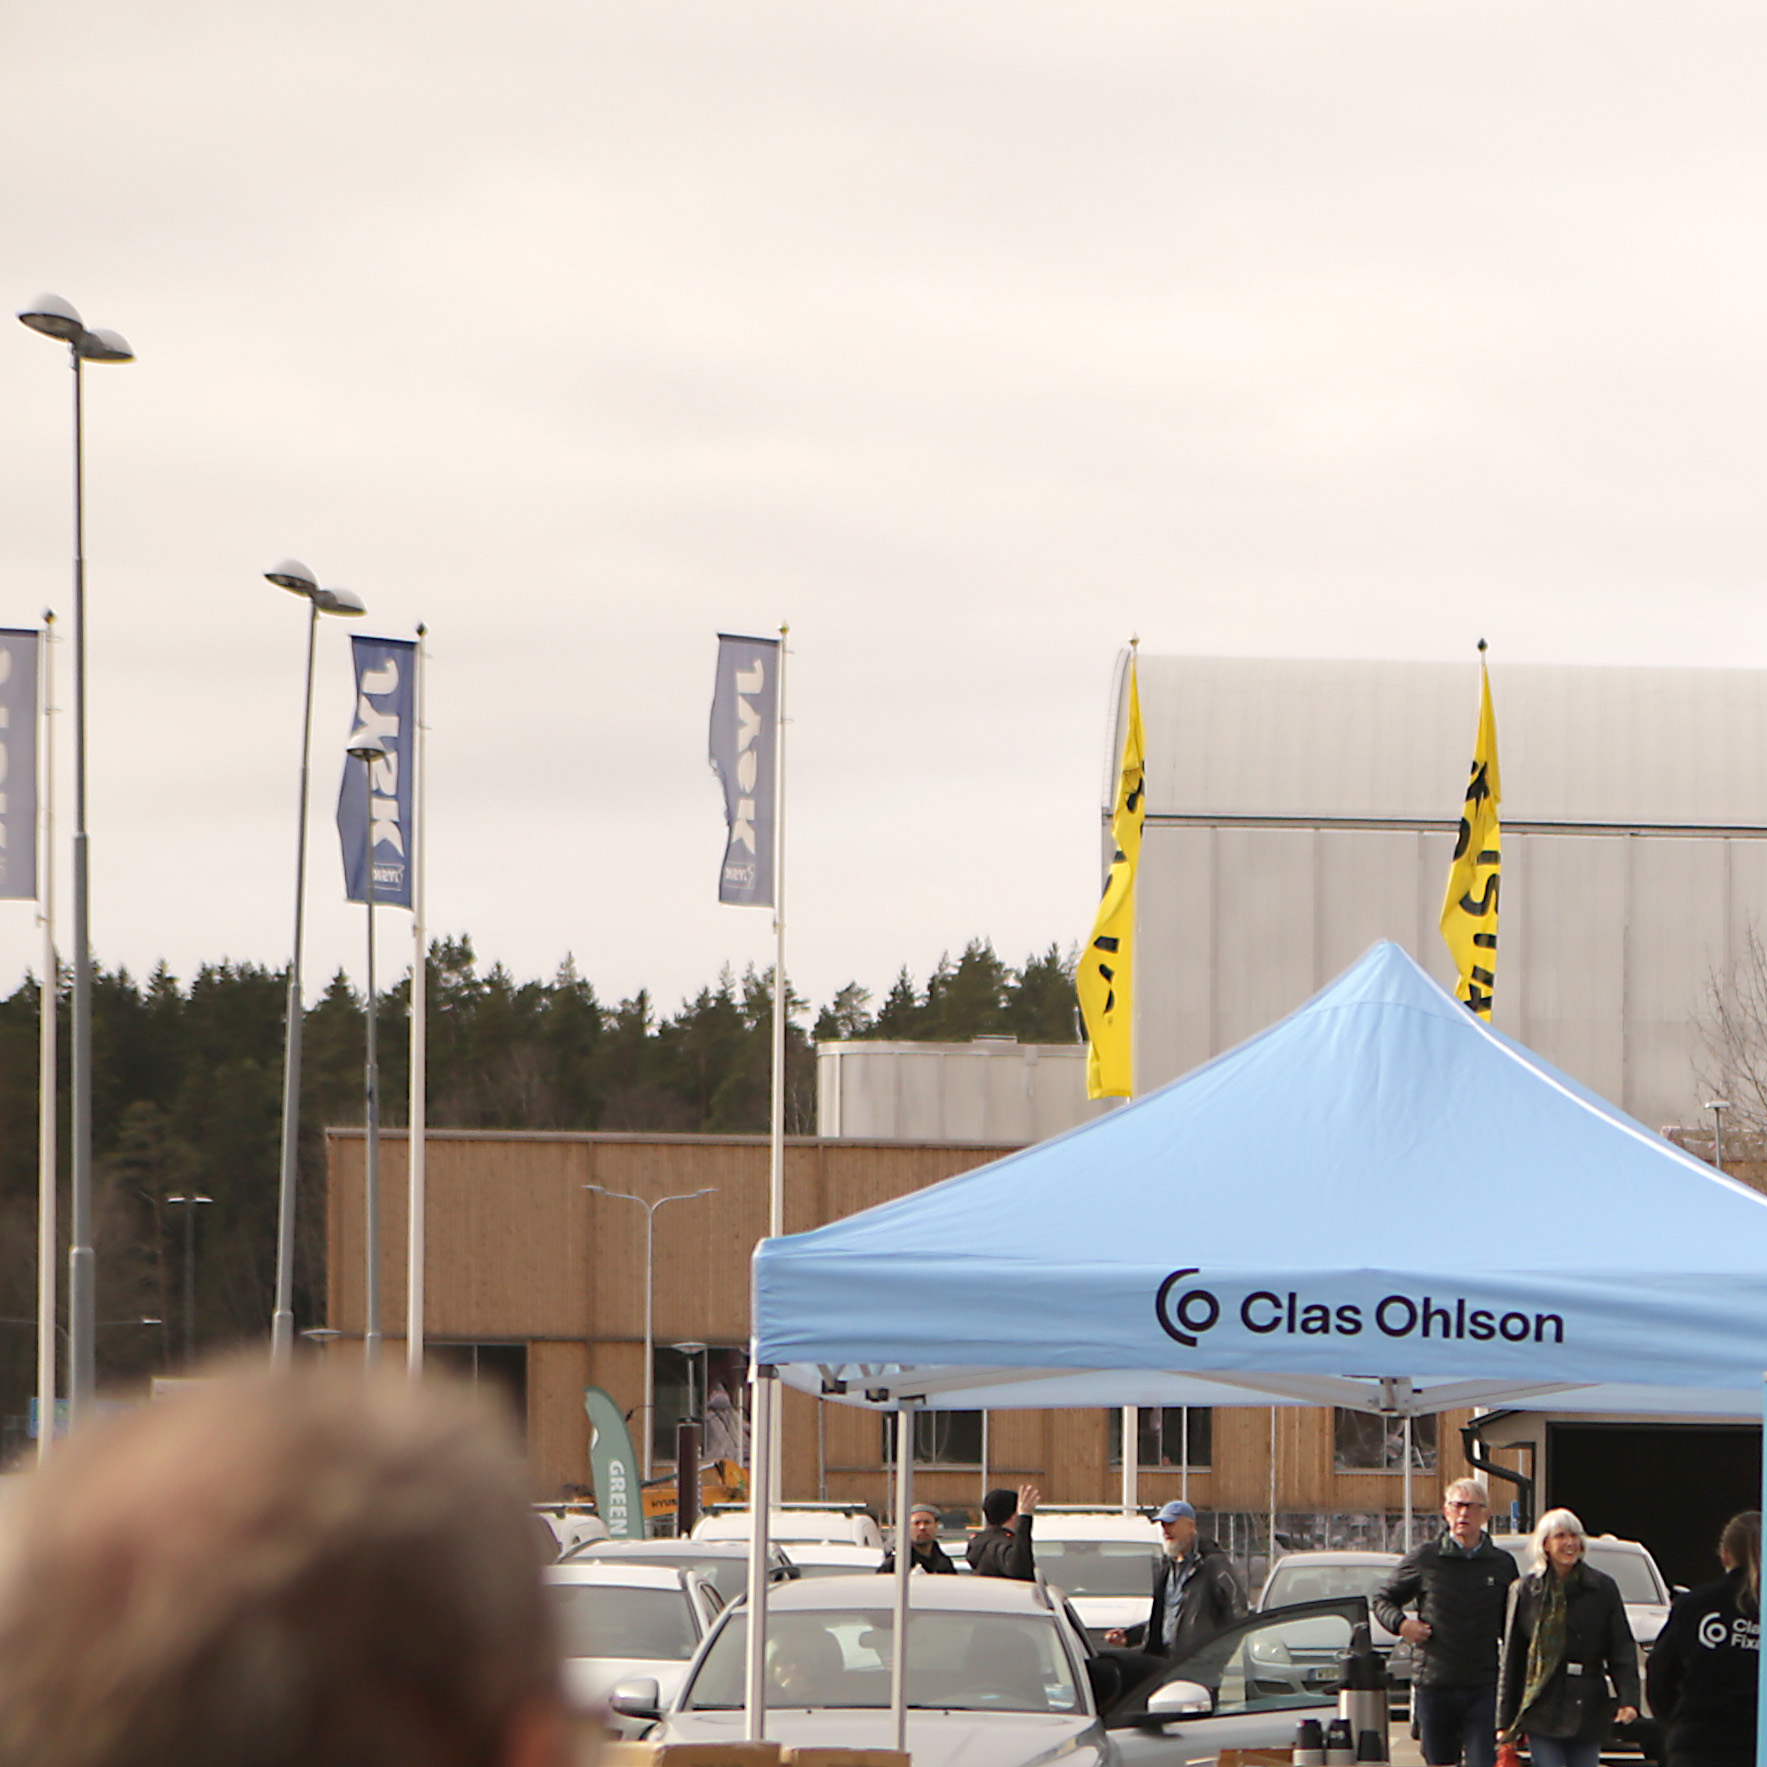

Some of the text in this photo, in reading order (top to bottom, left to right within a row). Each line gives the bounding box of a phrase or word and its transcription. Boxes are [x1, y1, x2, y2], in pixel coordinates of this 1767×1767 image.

[1240, 1290, 1564, 1344] Clas Ohlson
[608, 1460, 629, 1536] GREEN
[1732, 1617, 1760, 1635] Cla
